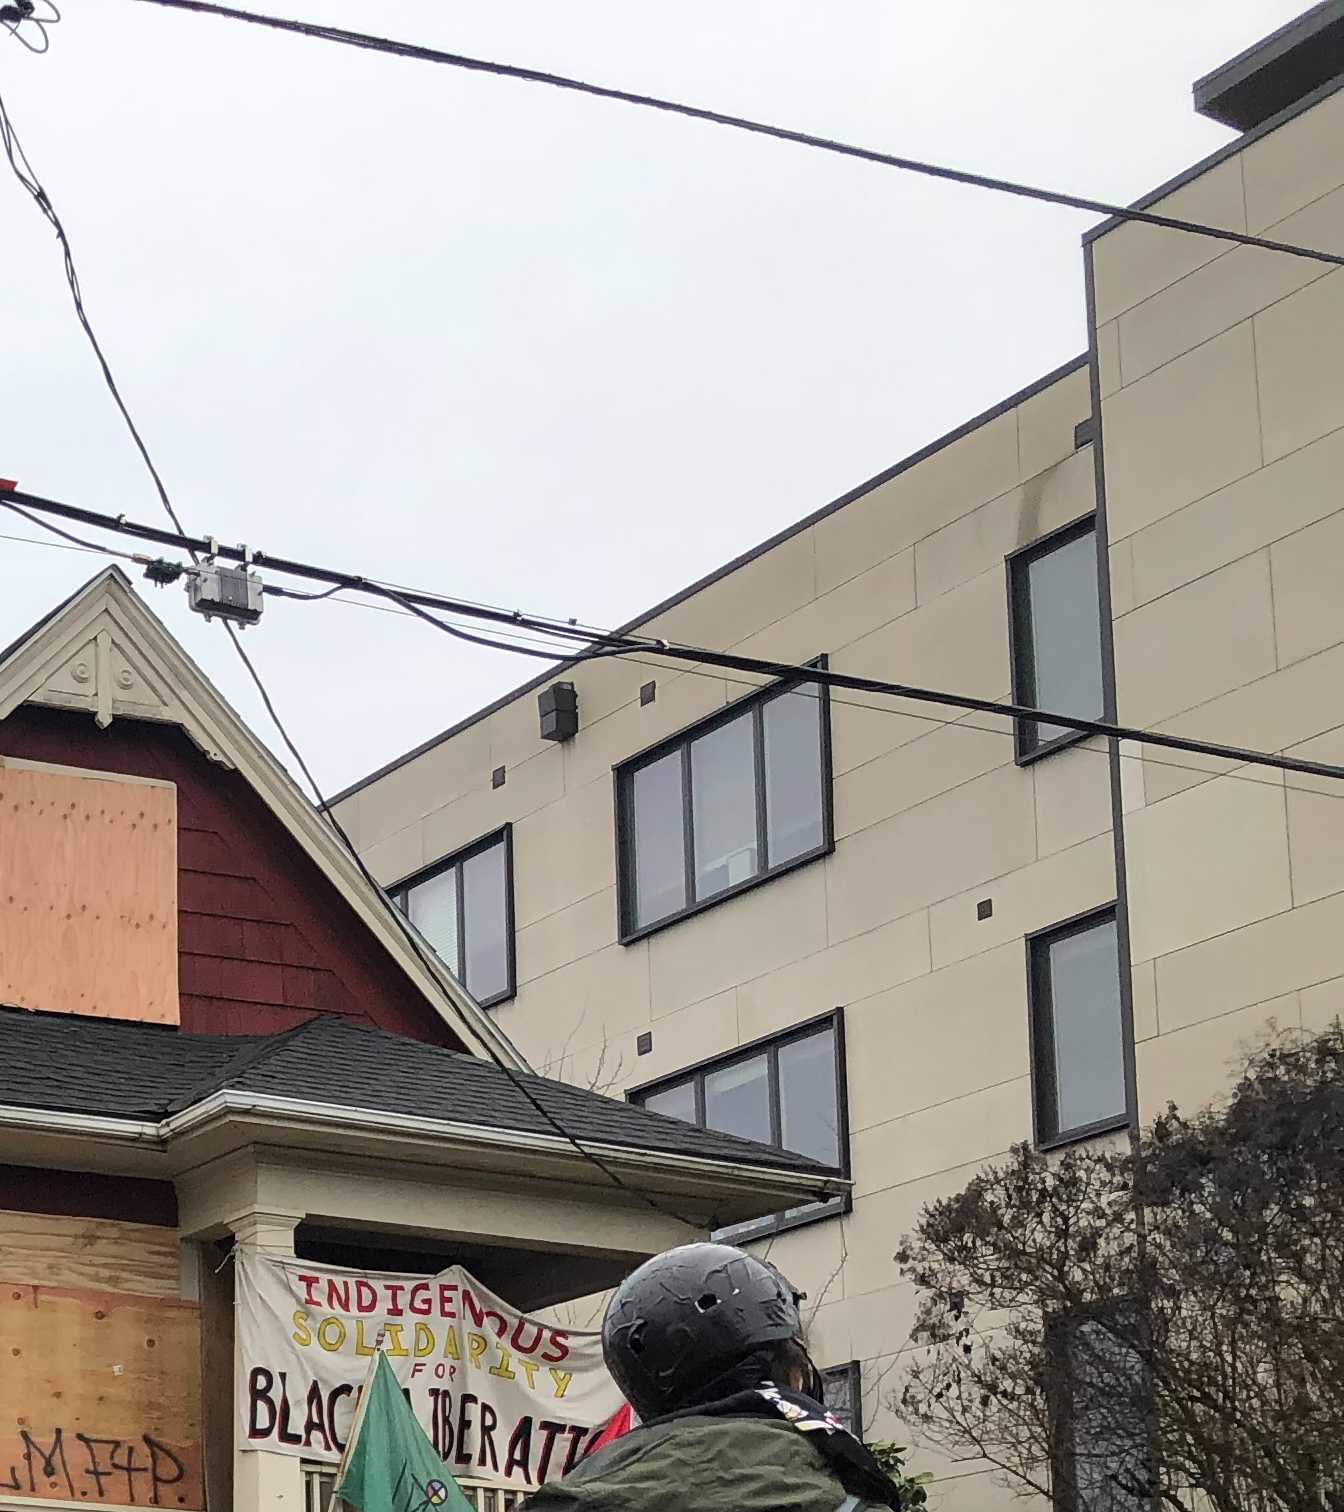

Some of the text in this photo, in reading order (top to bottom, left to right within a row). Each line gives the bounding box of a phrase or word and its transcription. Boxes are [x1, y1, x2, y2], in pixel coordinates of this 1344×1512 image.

[292, 1311, 574, 1399] SOLIDARITY
[298, 1274, 570, 1363] INDIGENOUS
[411, 1362, 457, 1382] FOR
[401, 1387, 605, 1486] IBERATI
